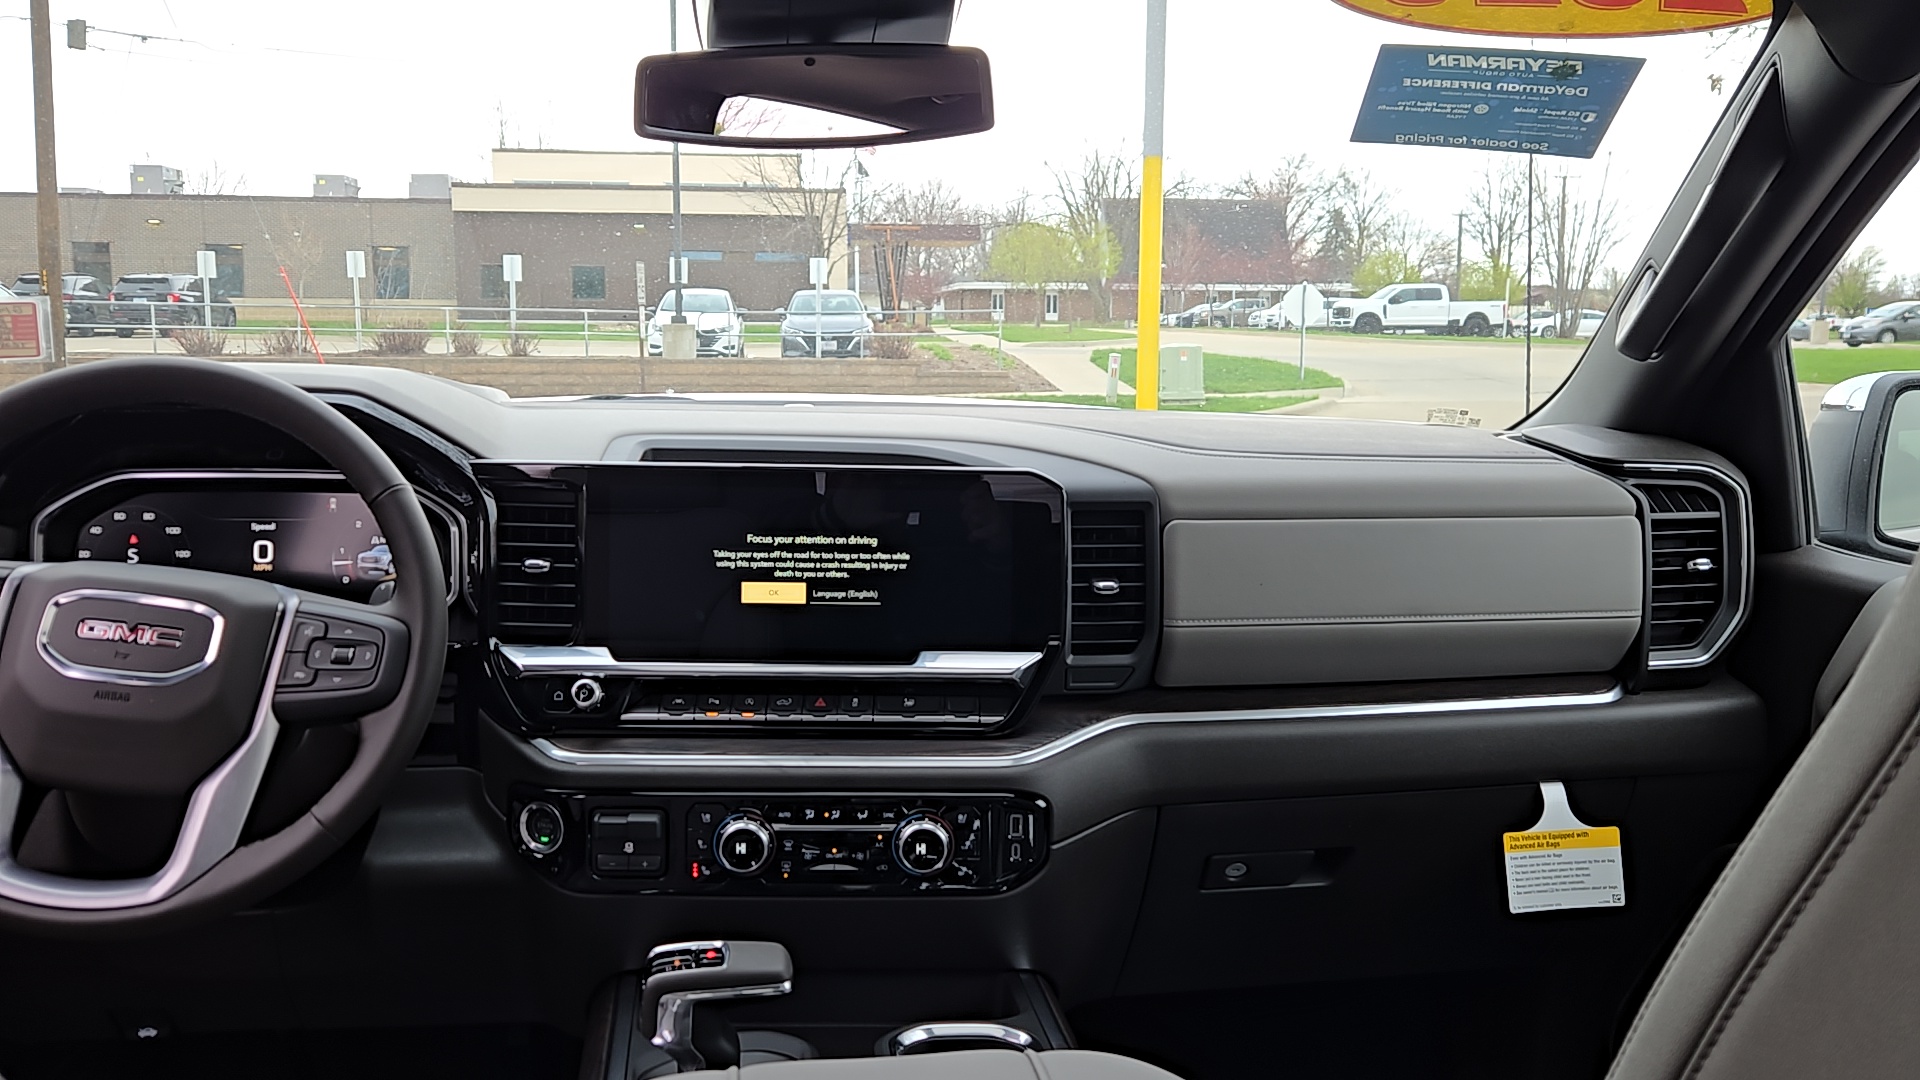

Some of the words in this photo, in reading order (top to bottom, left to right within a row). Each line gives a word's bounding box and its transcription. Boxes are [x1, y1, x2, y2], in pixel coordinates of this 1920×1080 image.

[89, 526, 103, 535] 40
[165, 526, 181, 535] 100
[251, 522, 276, 532] Speed
[747, 534, 773, 543] Focus
[774, 537, 794, 546] your
[794, 535, 834, 544] attention
[848, 535, 878, 547] driving
[127, 548, 139, 564] S
[253, 540, 274, 563] 0
[713, 550, 736, 560] Taking
[753, 552, 769, 560] eyes
[834, 552, 850, 561] long
[716, 560, 735, 569] using
[750, 561, 774, 569] system
[841, 561, 870, 570] resulting
[879, 562, 898, 571] injury
[826, 570, 850, 578] others.
[813, 590, 846, 599] Language
[847, 590, 878, 599] (English)
[77, 619, 184, 649] GMC
[94, 690, 130, 702] AIRBAG
[1549, 832, 1574, 841] Equipped
